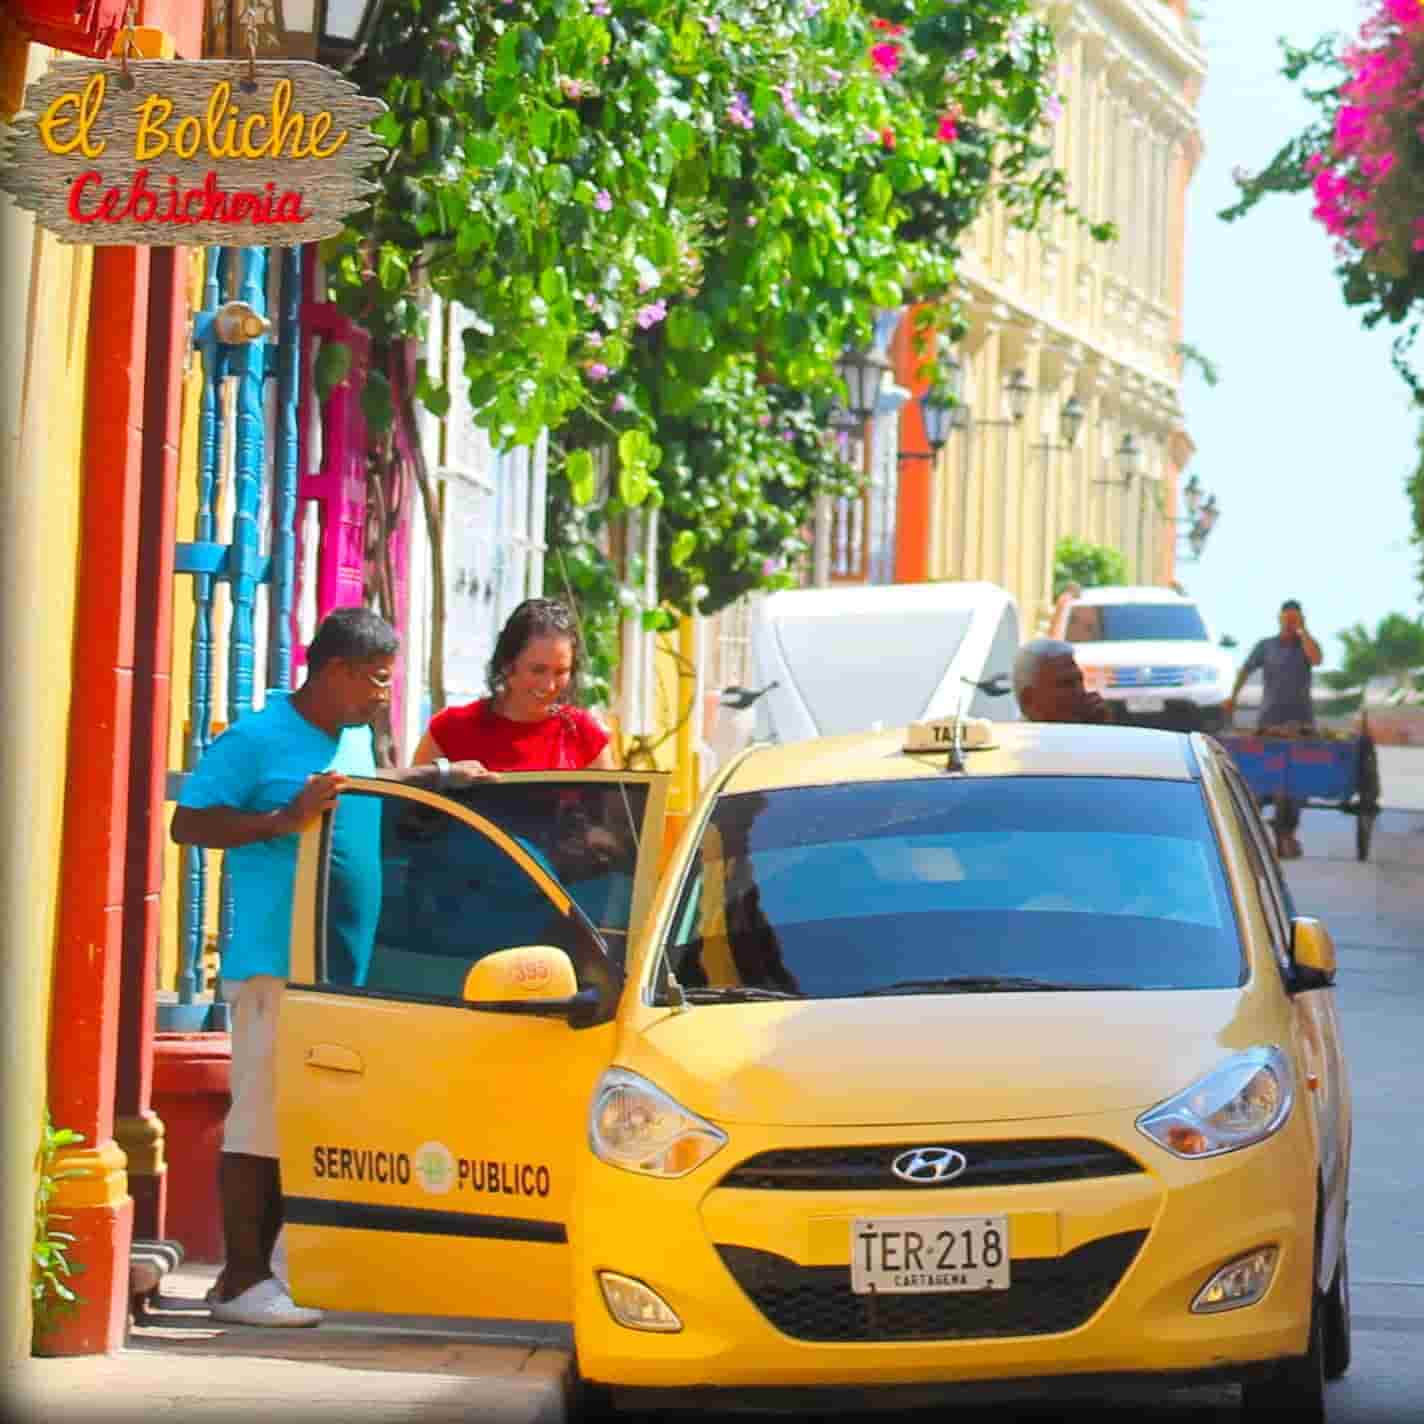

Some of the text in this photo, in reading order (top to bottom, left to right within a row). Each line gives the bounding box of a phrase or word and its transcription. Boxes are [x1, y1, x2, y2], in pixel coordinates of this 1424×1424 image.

[39, 73, 349, 162] El Boliche
[932, 726, 968, 743] TAI
[313, 1145, 551, 1198] SERVICIO PUBLICO
